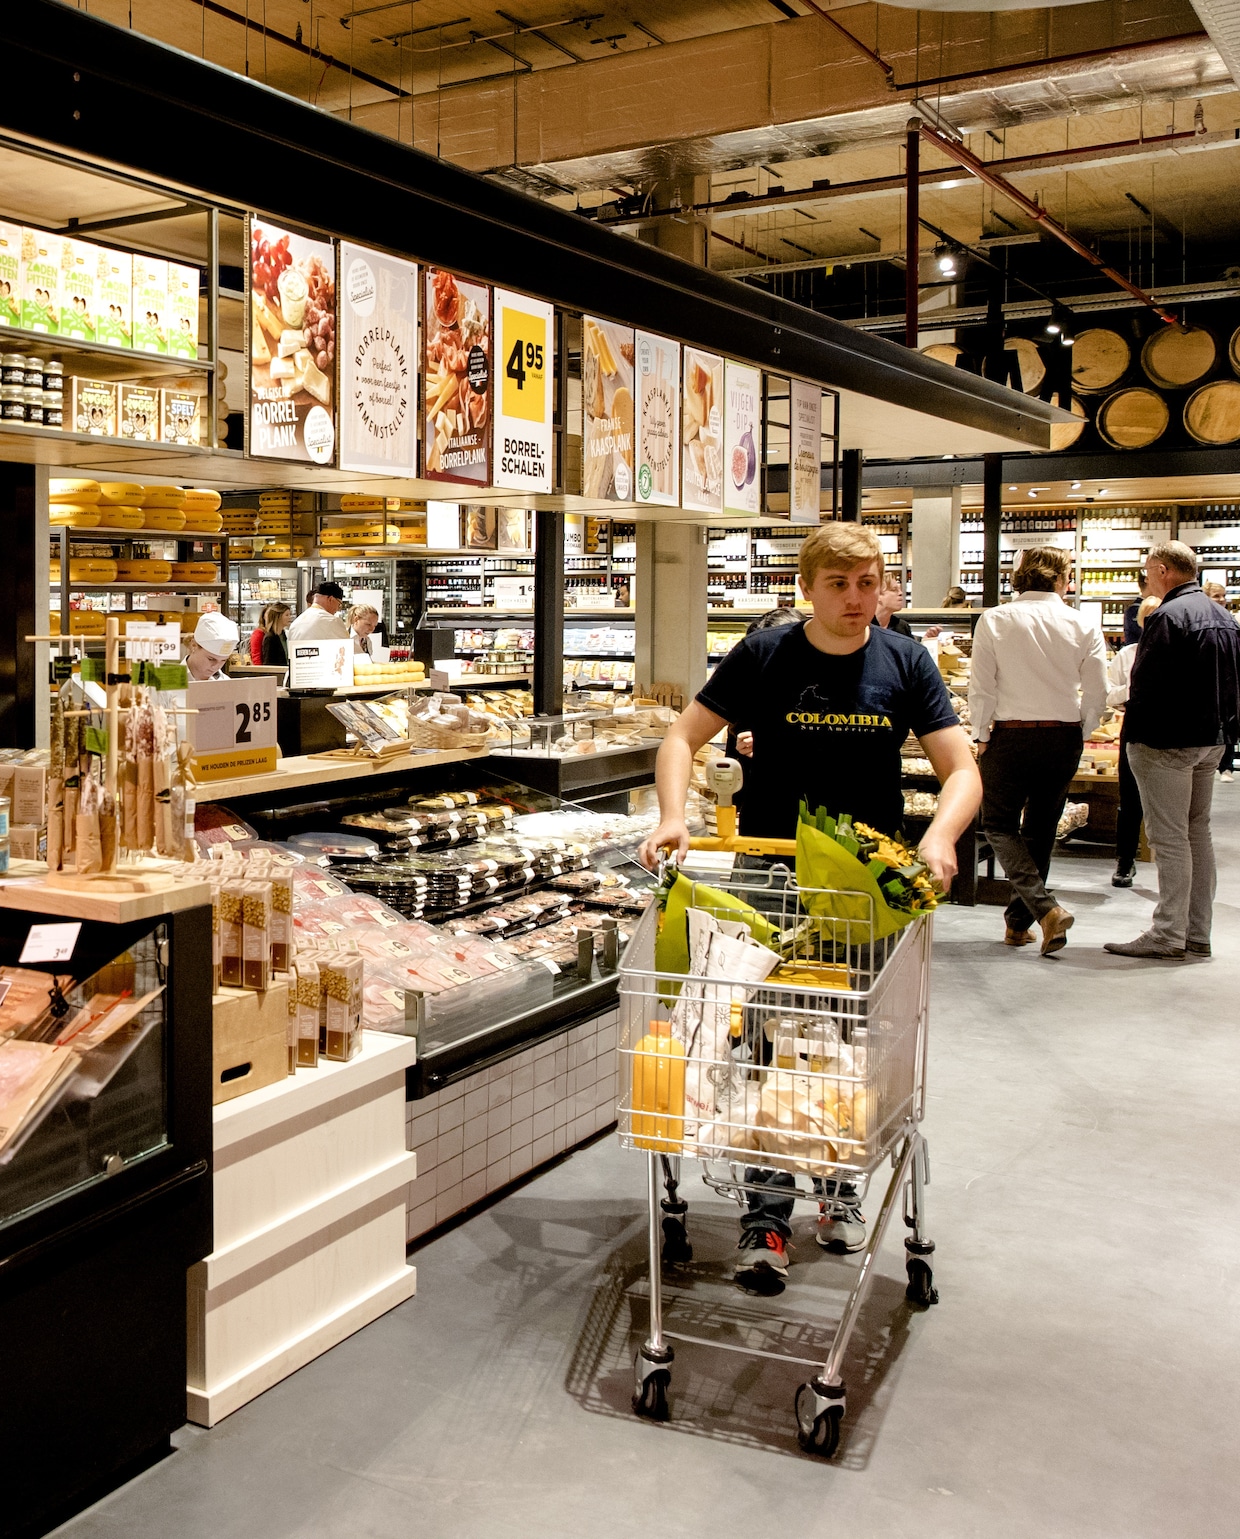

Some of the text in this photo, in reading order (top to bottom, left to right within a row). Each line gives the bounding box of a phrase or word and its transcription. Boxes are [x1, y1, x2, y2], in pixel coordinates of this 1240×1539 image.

[27, 273, 57, 289] PITTEN
[350, 286, 374, 302] Specialist
[355, 326, 408, 377] BORRELPLANK
[372, 357, 392, 373] Perfect
[731, 390, 754, 413] VIJGEN
[171, 403, 195, 417] SPELT
[254, 400, 299, 425] BORREL
[355, 389, 408, 439] SAMENSTELLEN
[600, 416, 622, 431] FRANSE
[259, 424, 298, 450] PLANK
[448, 434, 478, 449] ITALIAANSE
[504, 438, 544, 459] BORREL-
[591, 433, 631, 458] KAASPLANK
[440, 447, 486, 470] BORRELPLANK
[501, 458, 545, 479] SCHALEN
[643, 475, 648, 487] 7
[564, 533, 582, 542] UMBO
[785, 712, 893, 728] COLOMBIA
[210, 762, 229, 770] HOUDEN
[230, 760, 236, 768] DE
[237, 758, 255, 766] PRIJZEN
